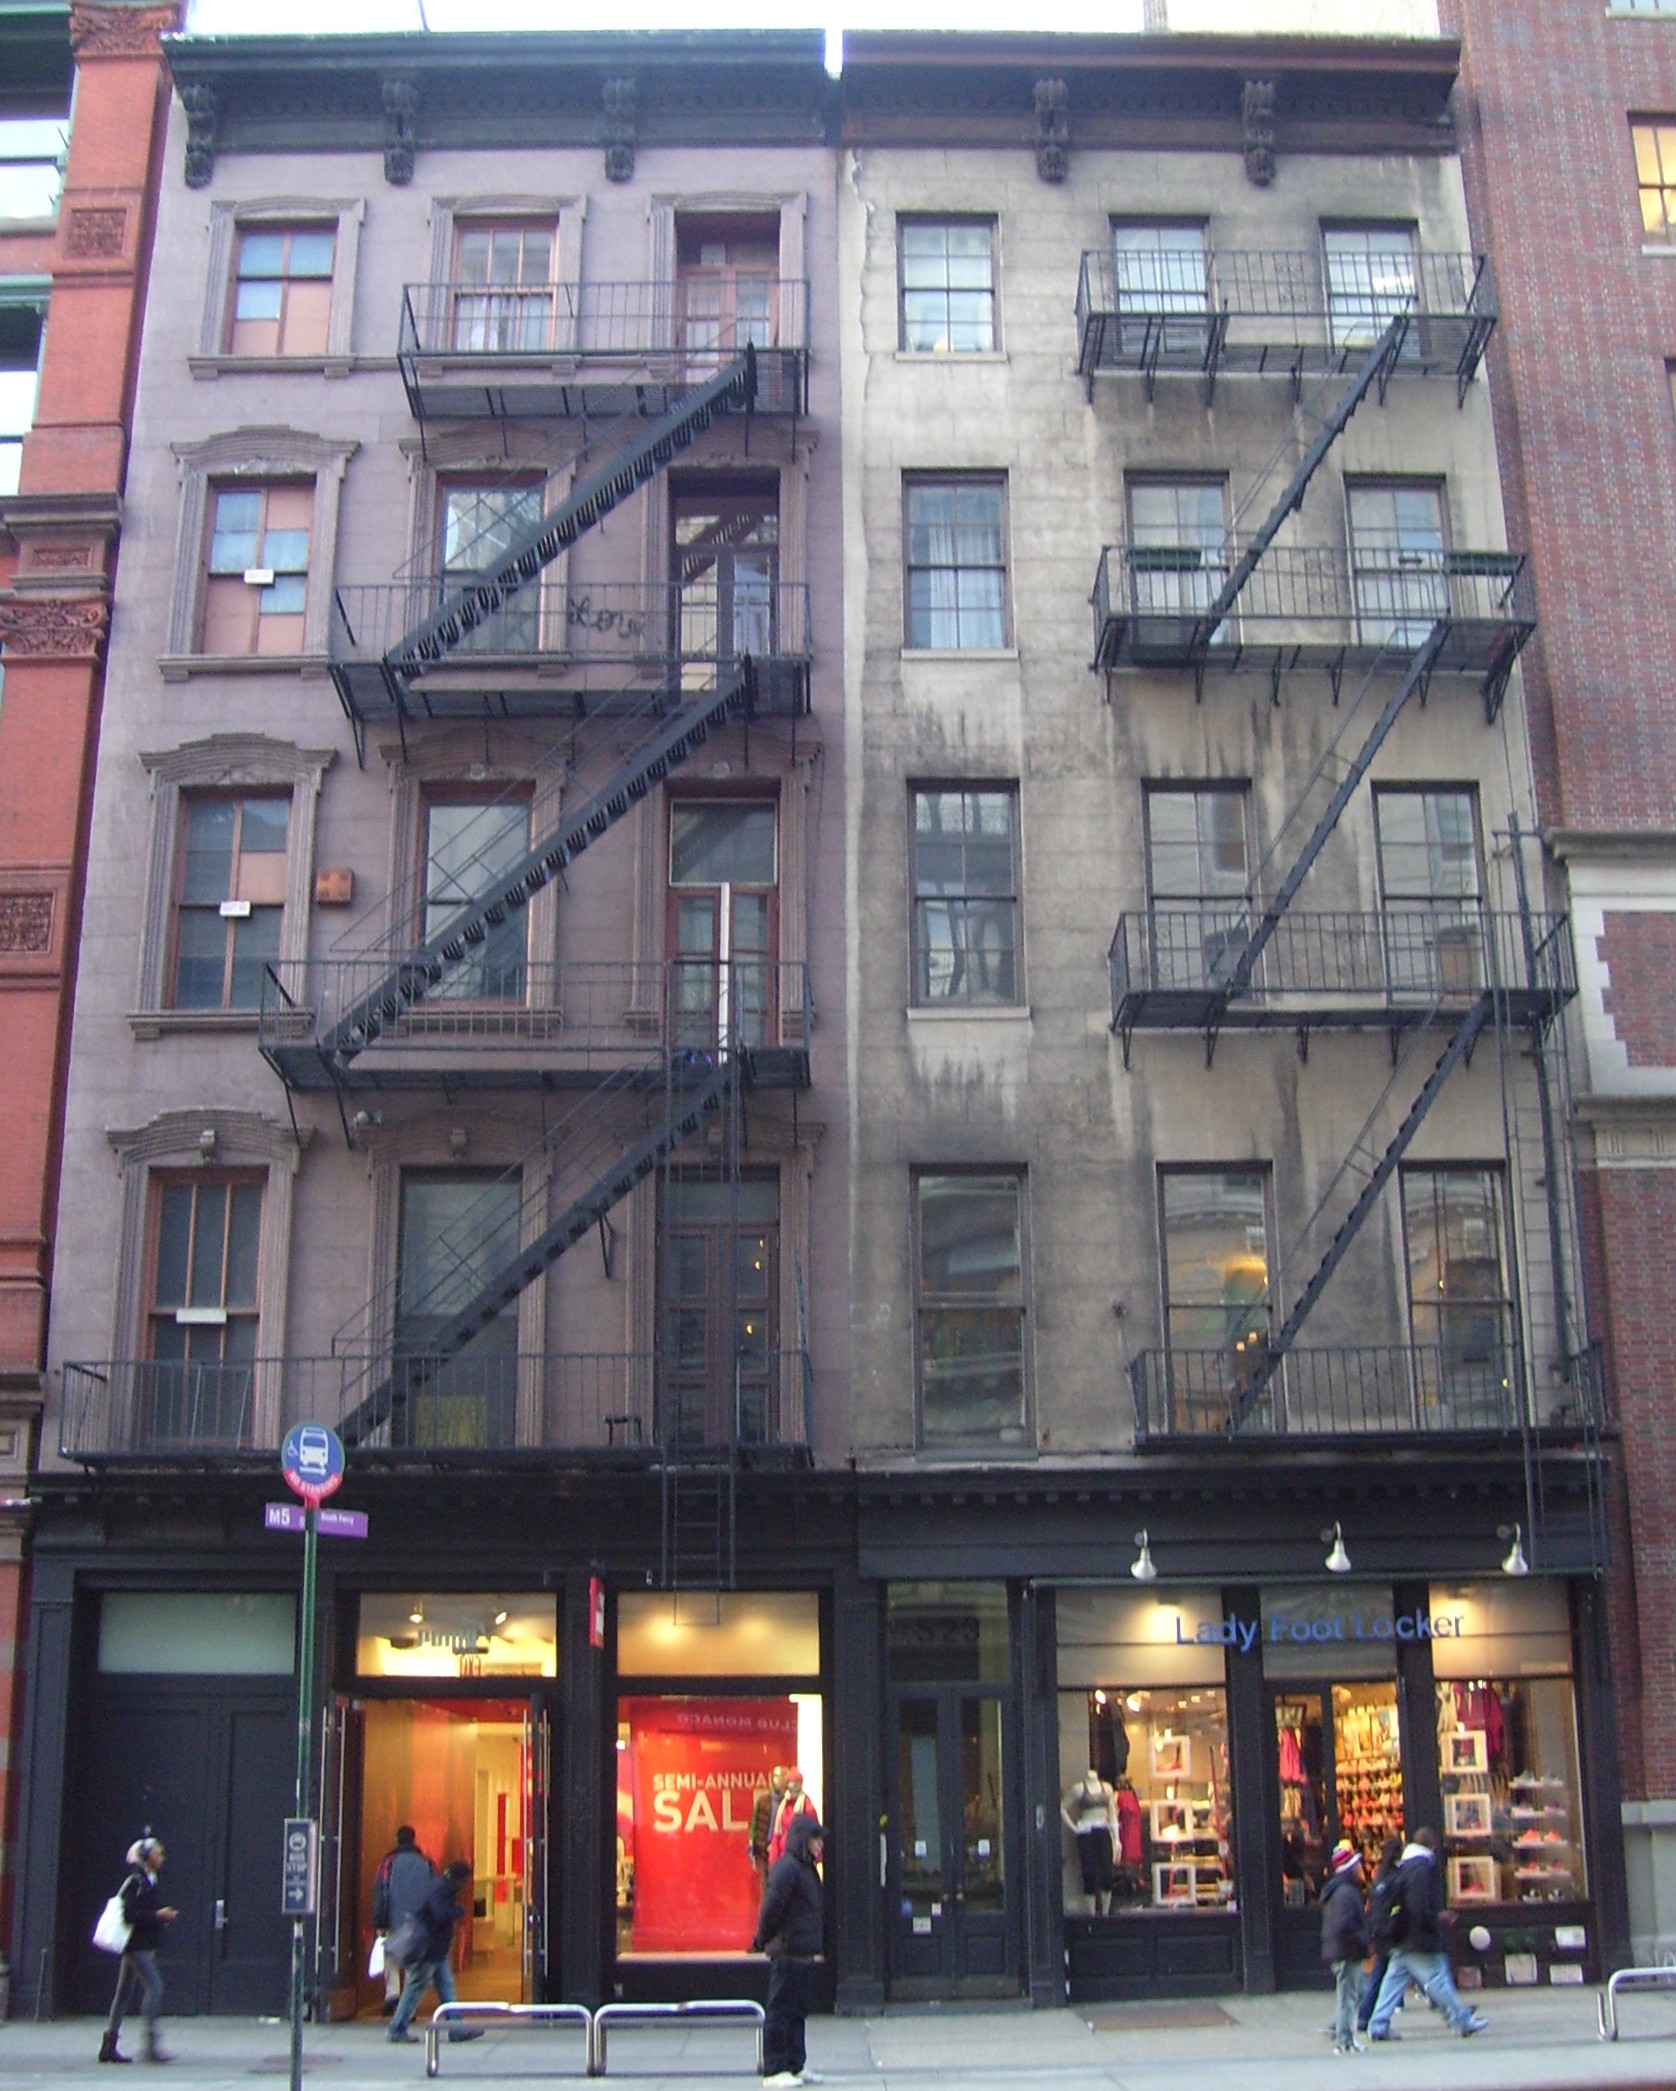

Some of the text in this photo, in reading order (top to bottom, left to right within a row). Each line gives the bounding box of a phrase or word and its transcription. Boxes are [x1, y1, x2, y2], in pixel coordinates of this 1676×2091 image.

[269, 1507, 290, 1526] M5
[1176, 1608, 1464, 1651] Lady Foot Locker
[653, 1789, 769, 1834] SAL
